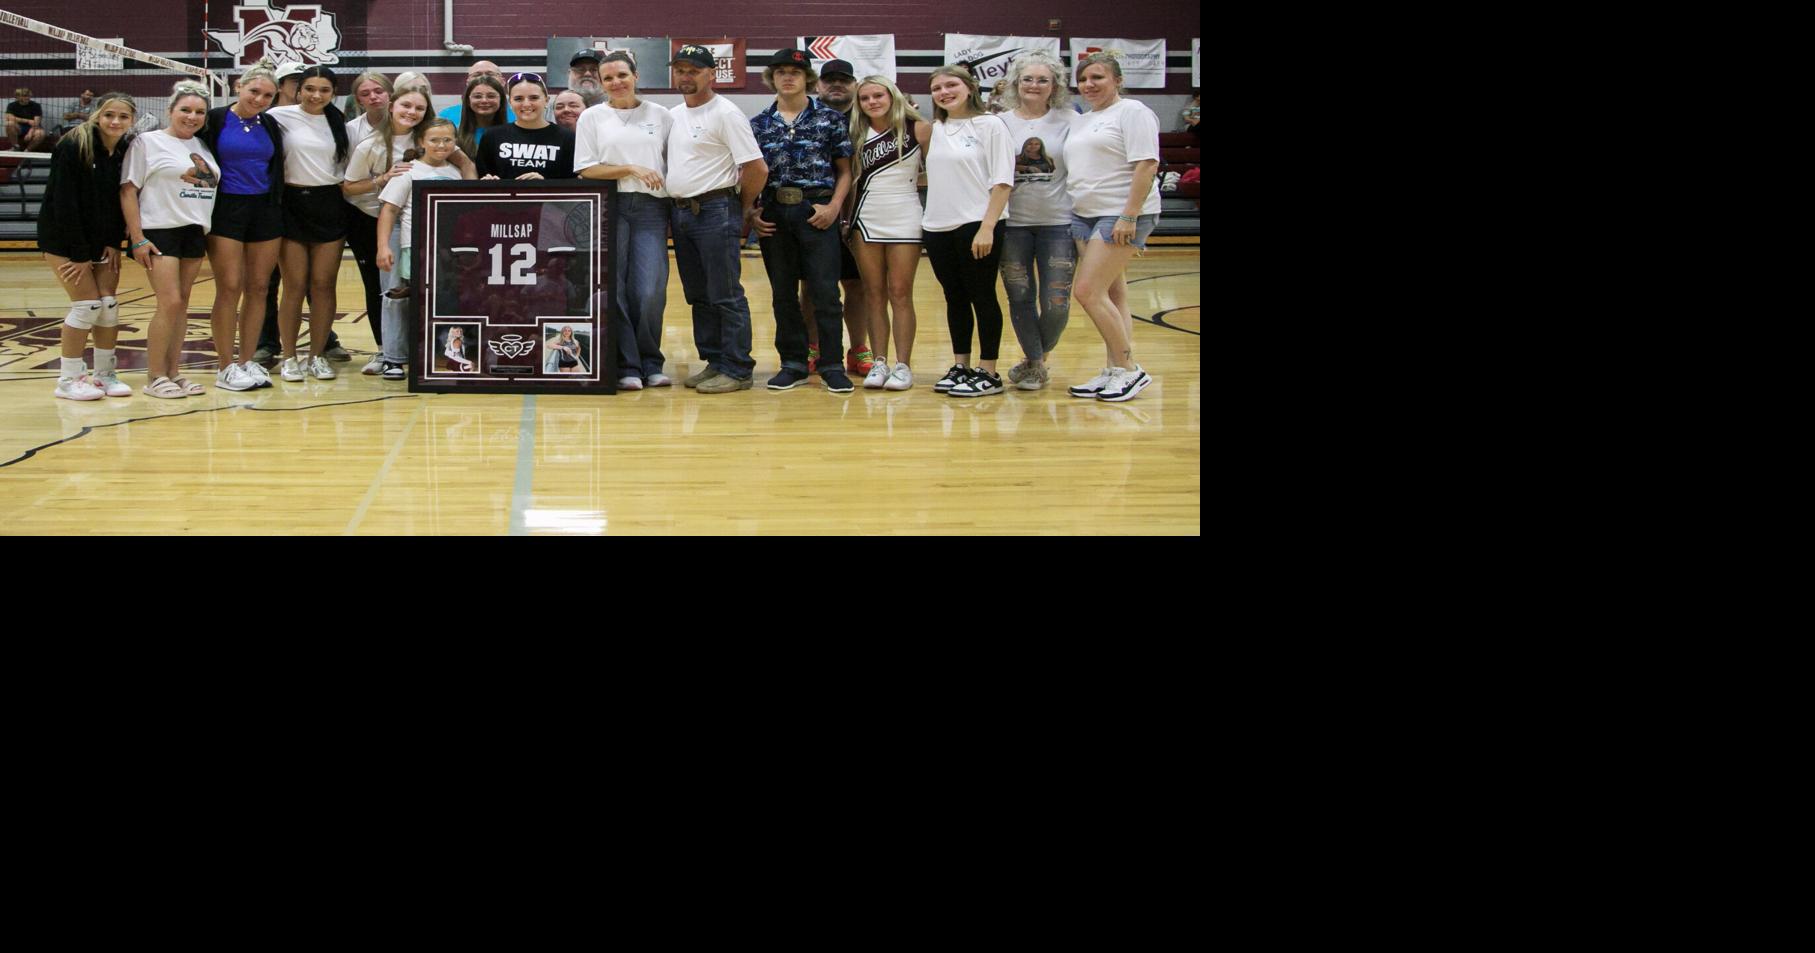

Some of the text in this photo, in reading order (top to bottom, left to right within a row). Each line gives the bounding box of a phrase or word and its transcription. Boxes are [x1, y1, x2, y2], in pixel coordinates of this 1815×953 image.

[954, 48, 972, 59] LADY
[714, 57, 736, 69] ECT
[715, 69, 737, 79] USE.
[498, 142, 561, 161] SWAT
[509, 158, 546, 168] TEAM
[490, 223, 533, 238] MILLSAP
[487, 243, 537, 285] 12
